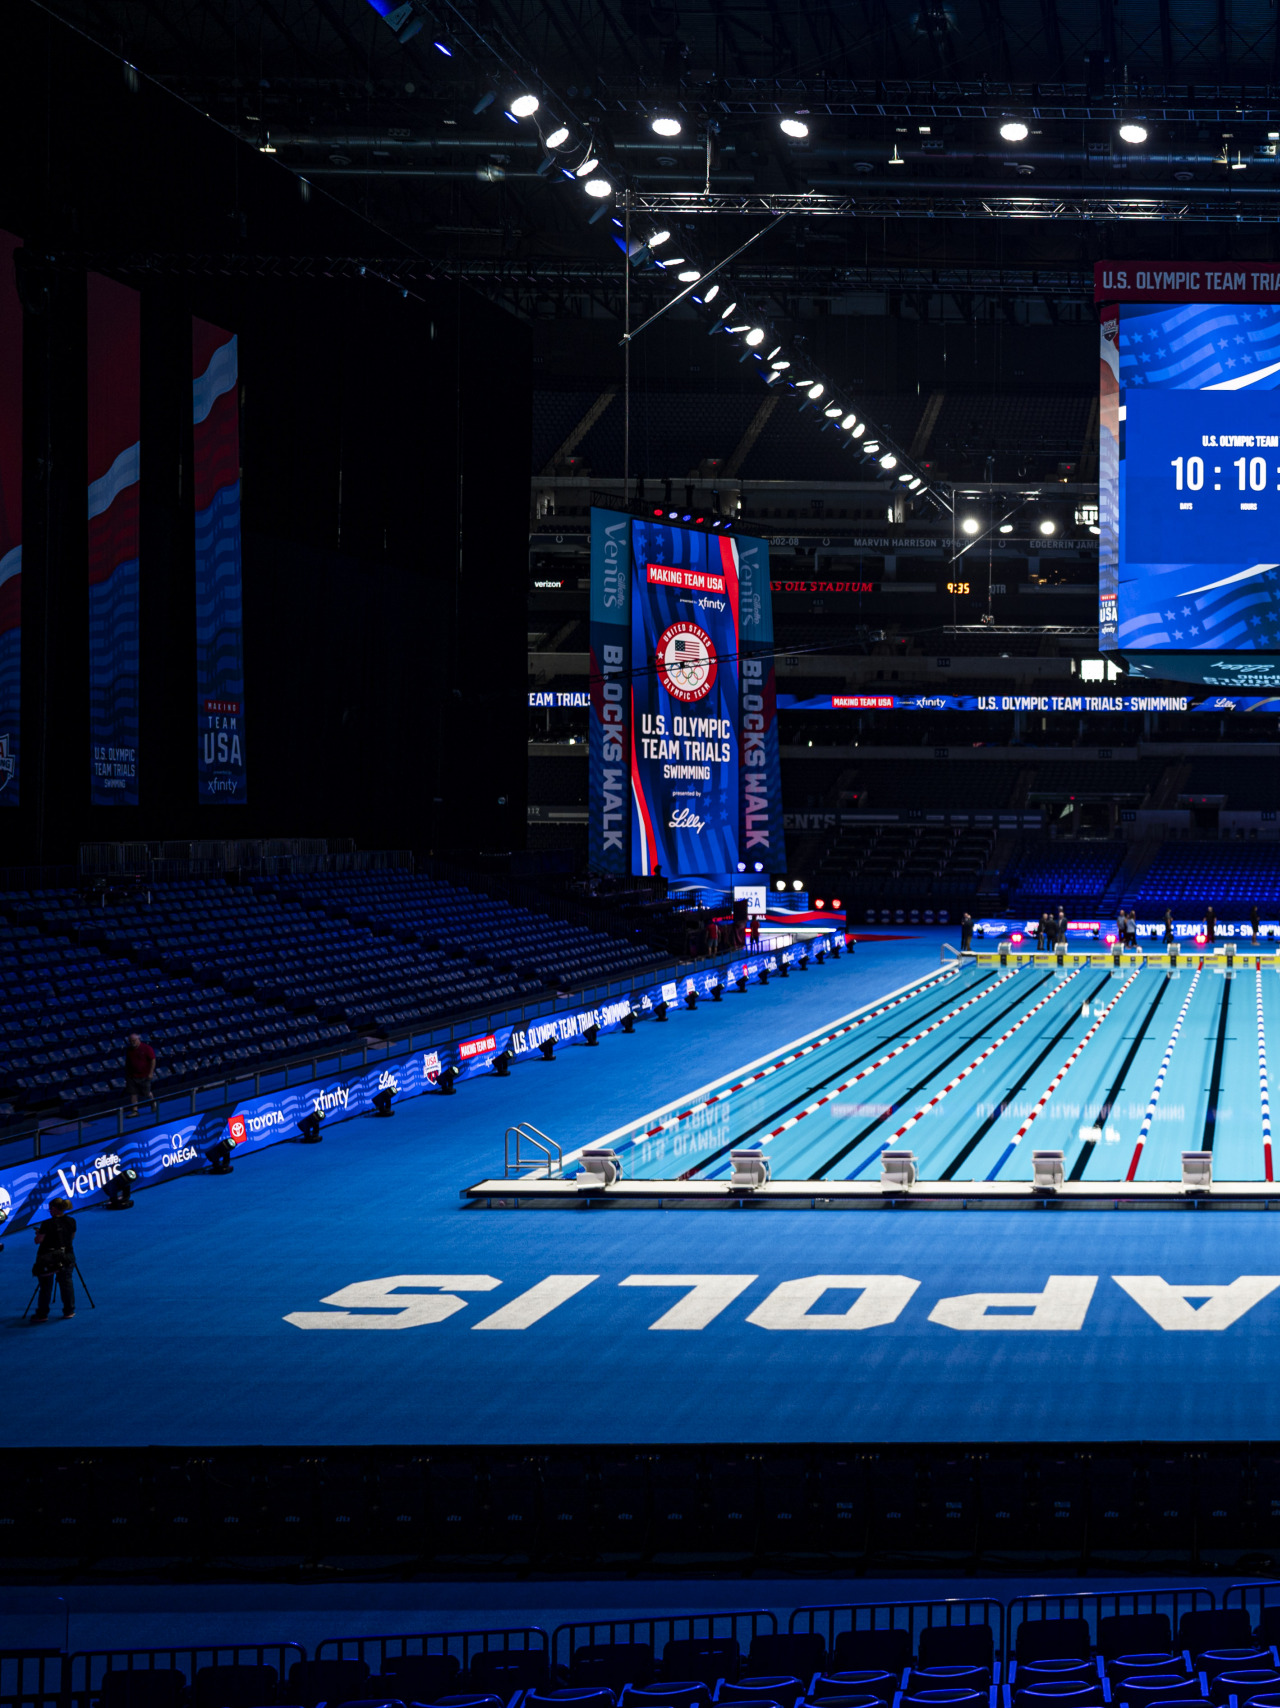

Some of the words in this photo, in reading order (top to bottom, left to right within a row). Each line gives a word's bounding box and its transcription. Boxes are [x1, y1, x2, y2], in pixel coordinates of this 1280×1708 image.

[1102, 272, 1131, 290] U.S.
[1136, 272, 1200, 291] OLYMPIC
[1205, 272, 1246, 291] TEAM
[1202, 436, 1218, 447] U.S.
[1219, 436, 1253, 447] OLYMPIC
[1255, 436, 1278, 447] TEAM
[1171, 457, 1204, 491] 10
[1233, 457, 1266, 491] 10
[891, 539, 937, 547] HARRISON
[604, 521, 627, 609] Venus
[534, 580, 561, 589] verizon
[649, 567, 683, 586] MAKING
[684, 572, 706, 588] TEAM
[706, 575, 724, 591] USA
[740, 546, 759, 627] Venus
[785, 581, 807, 592] OIL
[810, 581, 873, 592] STADIUM
[947, 582, 970, 594] 9:35
[698, 596, 726, 613] xfinity
[1099, 607, 1118, 623] USA
[663, 624, 687, 642] UNITED
[689, 624, 712, 648] STATES
[1210, 661, 1275, 672] Lilly
[663, 677, 692, 701] OLYMPIC
[693, 681, 711, 699] TEAM
[207, 702, 237, 712] MAKING
[602, 644, 624, 763] BLOCKS
[833, 698, 859, 707] MAKING
[859, 698, 877, 707] TEAM
[878, 698, 892, 707] USA
[916, 698, 946, 708] xfinity
[978, 697, 998, 711] U.S.
[1002, 697, 1048, 711] OLYMPIC
[1051, 697, 1082, 711] TEAM
[1085, 697, 1123, 711] TRIALS
[1131, 697, 1188, 711] SWIMMING
[1214, 698, 1237, 711] Lilly
[742, 660, 766, 767] BLOCKS
[208, 716, 237, 730] TEAM
[642, 713, 669, 735] U.S.
[673, 715, 731, 739] OLYMPIC
[95, 747, 108, 760] U.S.
[108, 748, 136, 762] OLYMPIC
[203, 732, 243, 767] USA
[641, 738, 680, 761] TEAM
[683, 741, 731, 763] TRIALS
[94, 763, 112, 776] TEAM
[113, 764, 136, 777] TRIALS
[663, 764, 711, 780] SWIMMING
[207, 776, 238, 794] xfinity
[672, 790, 695, 798] presented
[602, 768, 624, 851] WALK
[745, 774, 771, 850] WALK
[668, 808, 706, 834] Lilly
[512, 1031, 528, 1054] U.S.
[57, 1162, 121, 1198] Venus
[162, 1148, 198, 1168] OMEGA
[248, 1111, 285, 1131] TOYOTA
[313, 1087, 349, 1114] xfinity
[379, 1070, 398, 1091] Lilly
[426, 1055, 438, 1067] USA
[94, 1154, 121, 1169] Gillette
